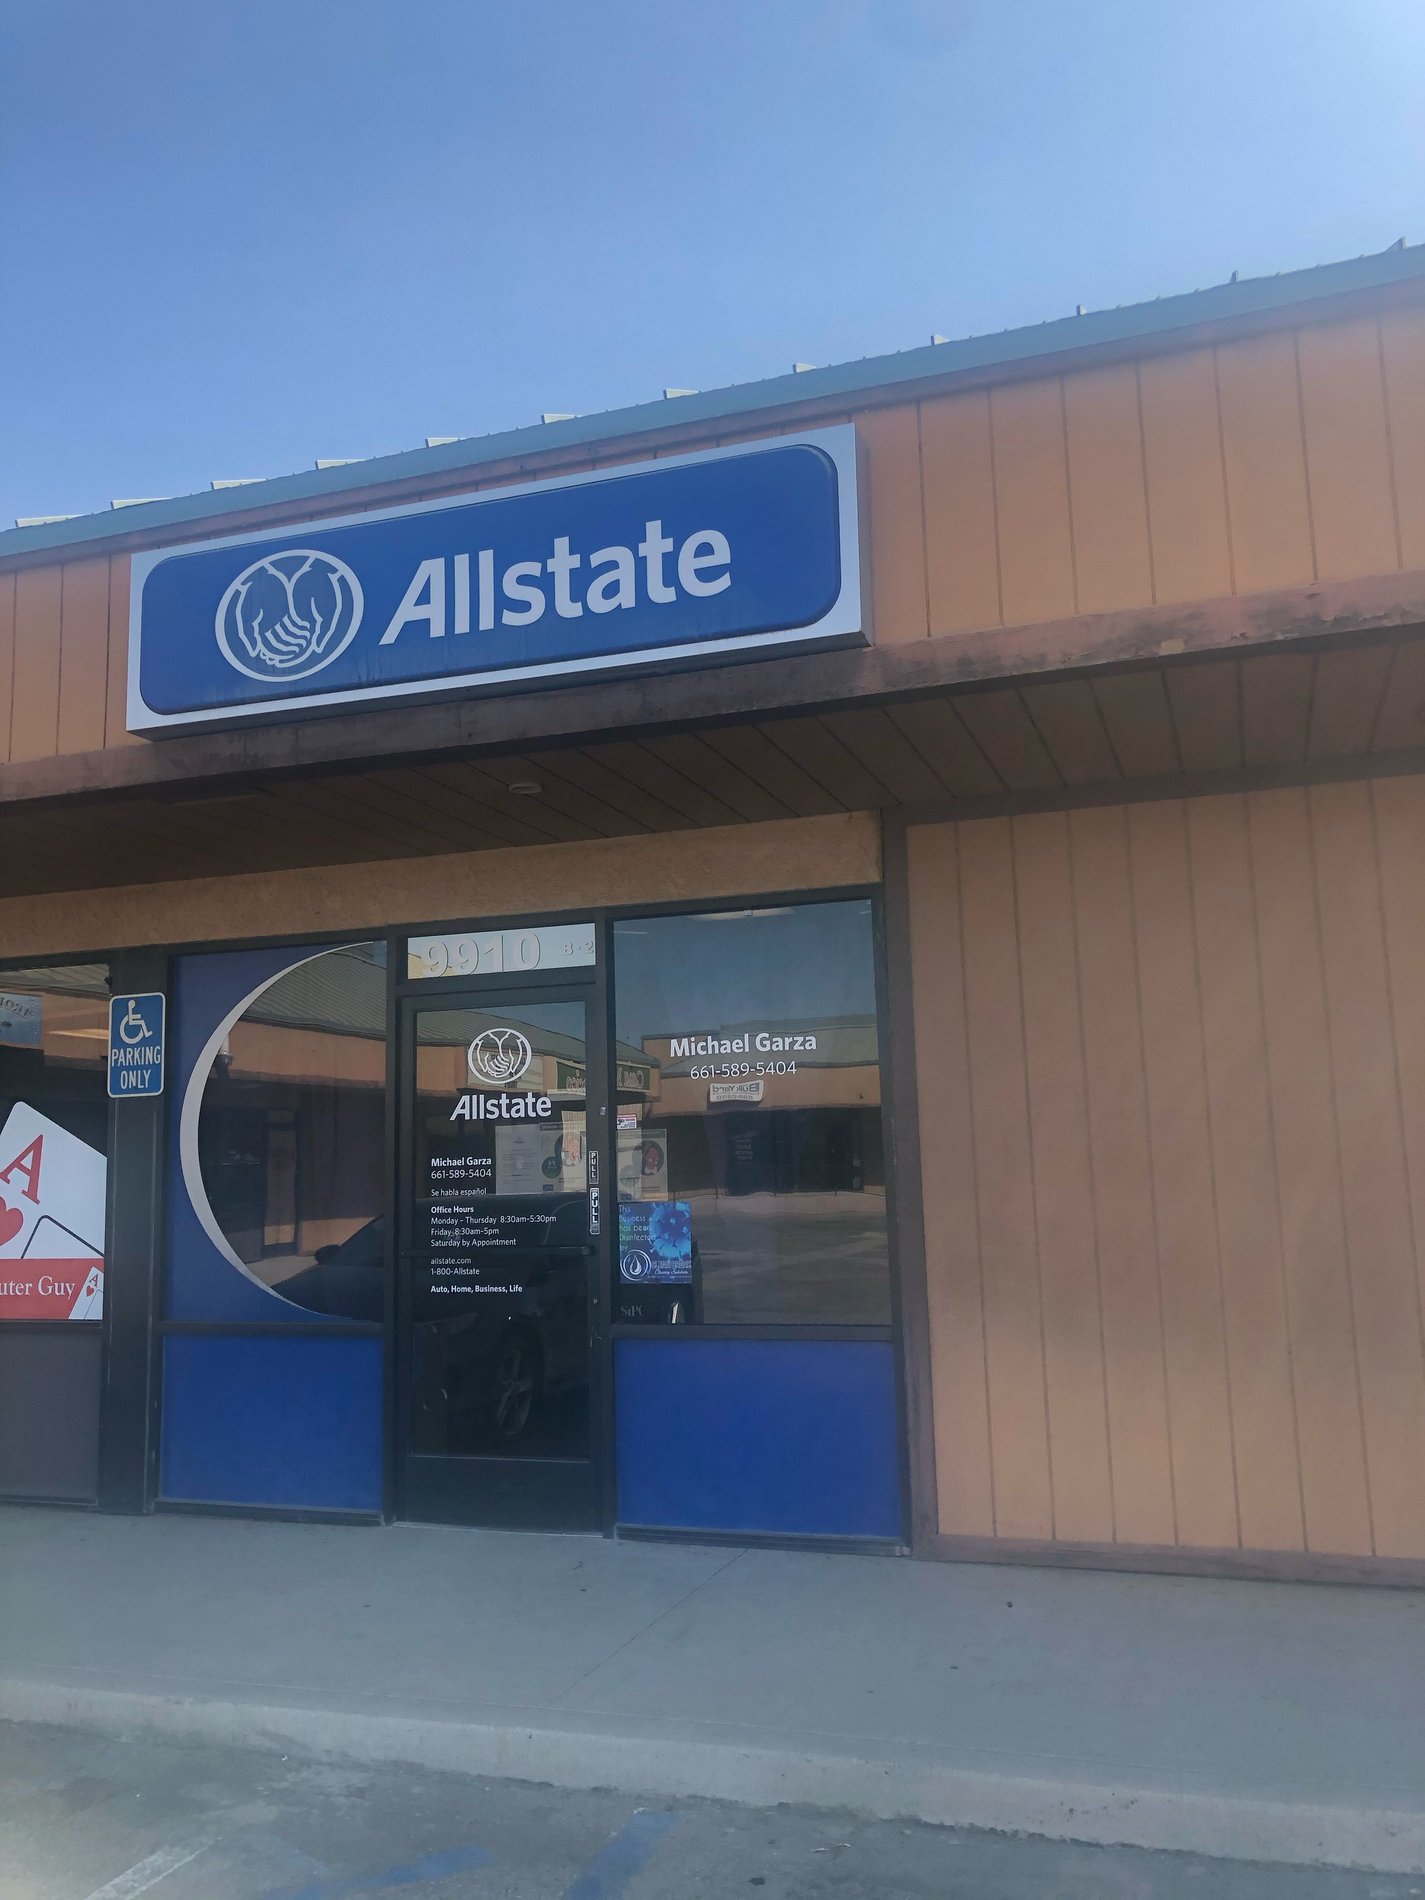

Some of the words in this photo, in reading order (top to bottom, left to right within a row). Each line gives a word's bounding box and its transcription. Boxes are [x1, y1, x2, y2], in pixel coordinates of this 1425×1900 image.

[379, 520, 731, 645] Allstate
[423, 932, 541, 978] 9910
[670, 1033, 749, 1057] Michael
[755, 1032, 817, 1052] Garza
[111, 1046, 161, 1067] PARKING
[120, 1069, 151, 1090] ONLY
[690, 1060, 797, 1080] 661-589-5404
[450, 1092, 552, 1121] Allstate
[0, 1134, 43, 1205] A
[431, 1156, 465, 1167] Michael
[466, 1156, 492, 1166] Garza
[430, 1168, 492, 1179] 661-589-5404
[431, 1188, 439, 1197] Se
[440, 1188, 459, 1196] habla
[460, 1187, 487, 1197] español
[430, 1206, 452, 1214] Office
[453, 1205, 474, 1213] Hours
[430, 1217, 459, 1226] Monday
[465, 1216, 497, 1225] Thursday
[500, 1214, 557, 1224] 8:30am-5:30pm
[454, 1227, 500, 1236] 8:30am-5pm
[430, 1239, 461, 1248] Saturday
[461, 1239, 471, 1248] by
[471, 1238, 517, 1247] Appointment
[38, 1275, 76, 1300] Guy
[430, 1285, 449, 1294] Auto,
[451, 1285, 474, 1294] Home,
[474, 1285, 508, 1294] Business,
[509, 1284, 523, 1293] Life
